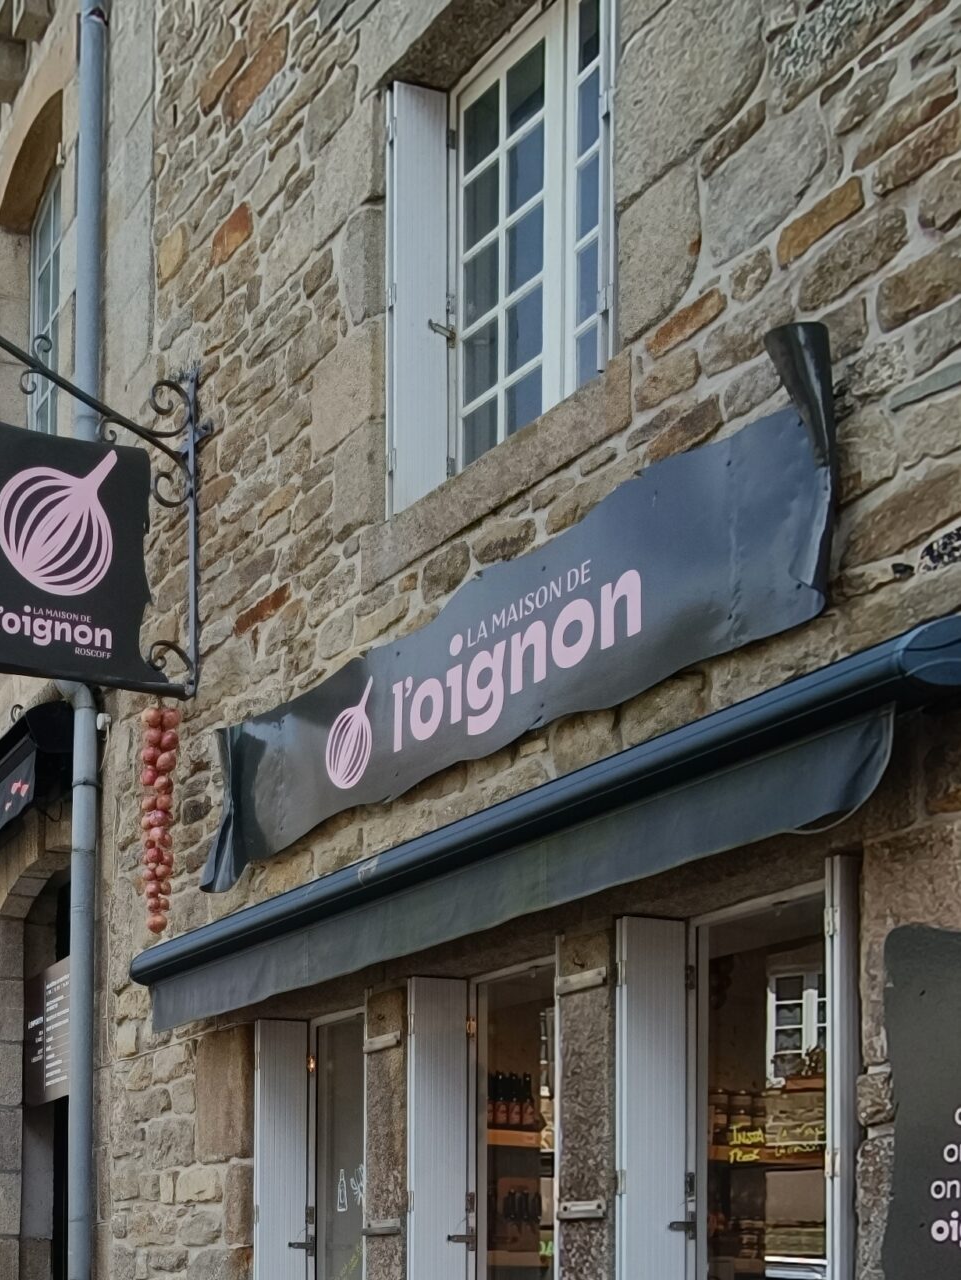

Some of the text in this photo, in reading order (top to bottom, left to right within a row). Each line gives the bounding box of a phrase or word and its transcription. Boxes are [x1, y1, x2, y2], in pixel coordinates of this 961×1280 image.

[467, 560, 592, 648] LA MAISON DE
[33, 606, 92, 624] LA MAISON DE
[74, 646, 112, 660] ROSCOFF
